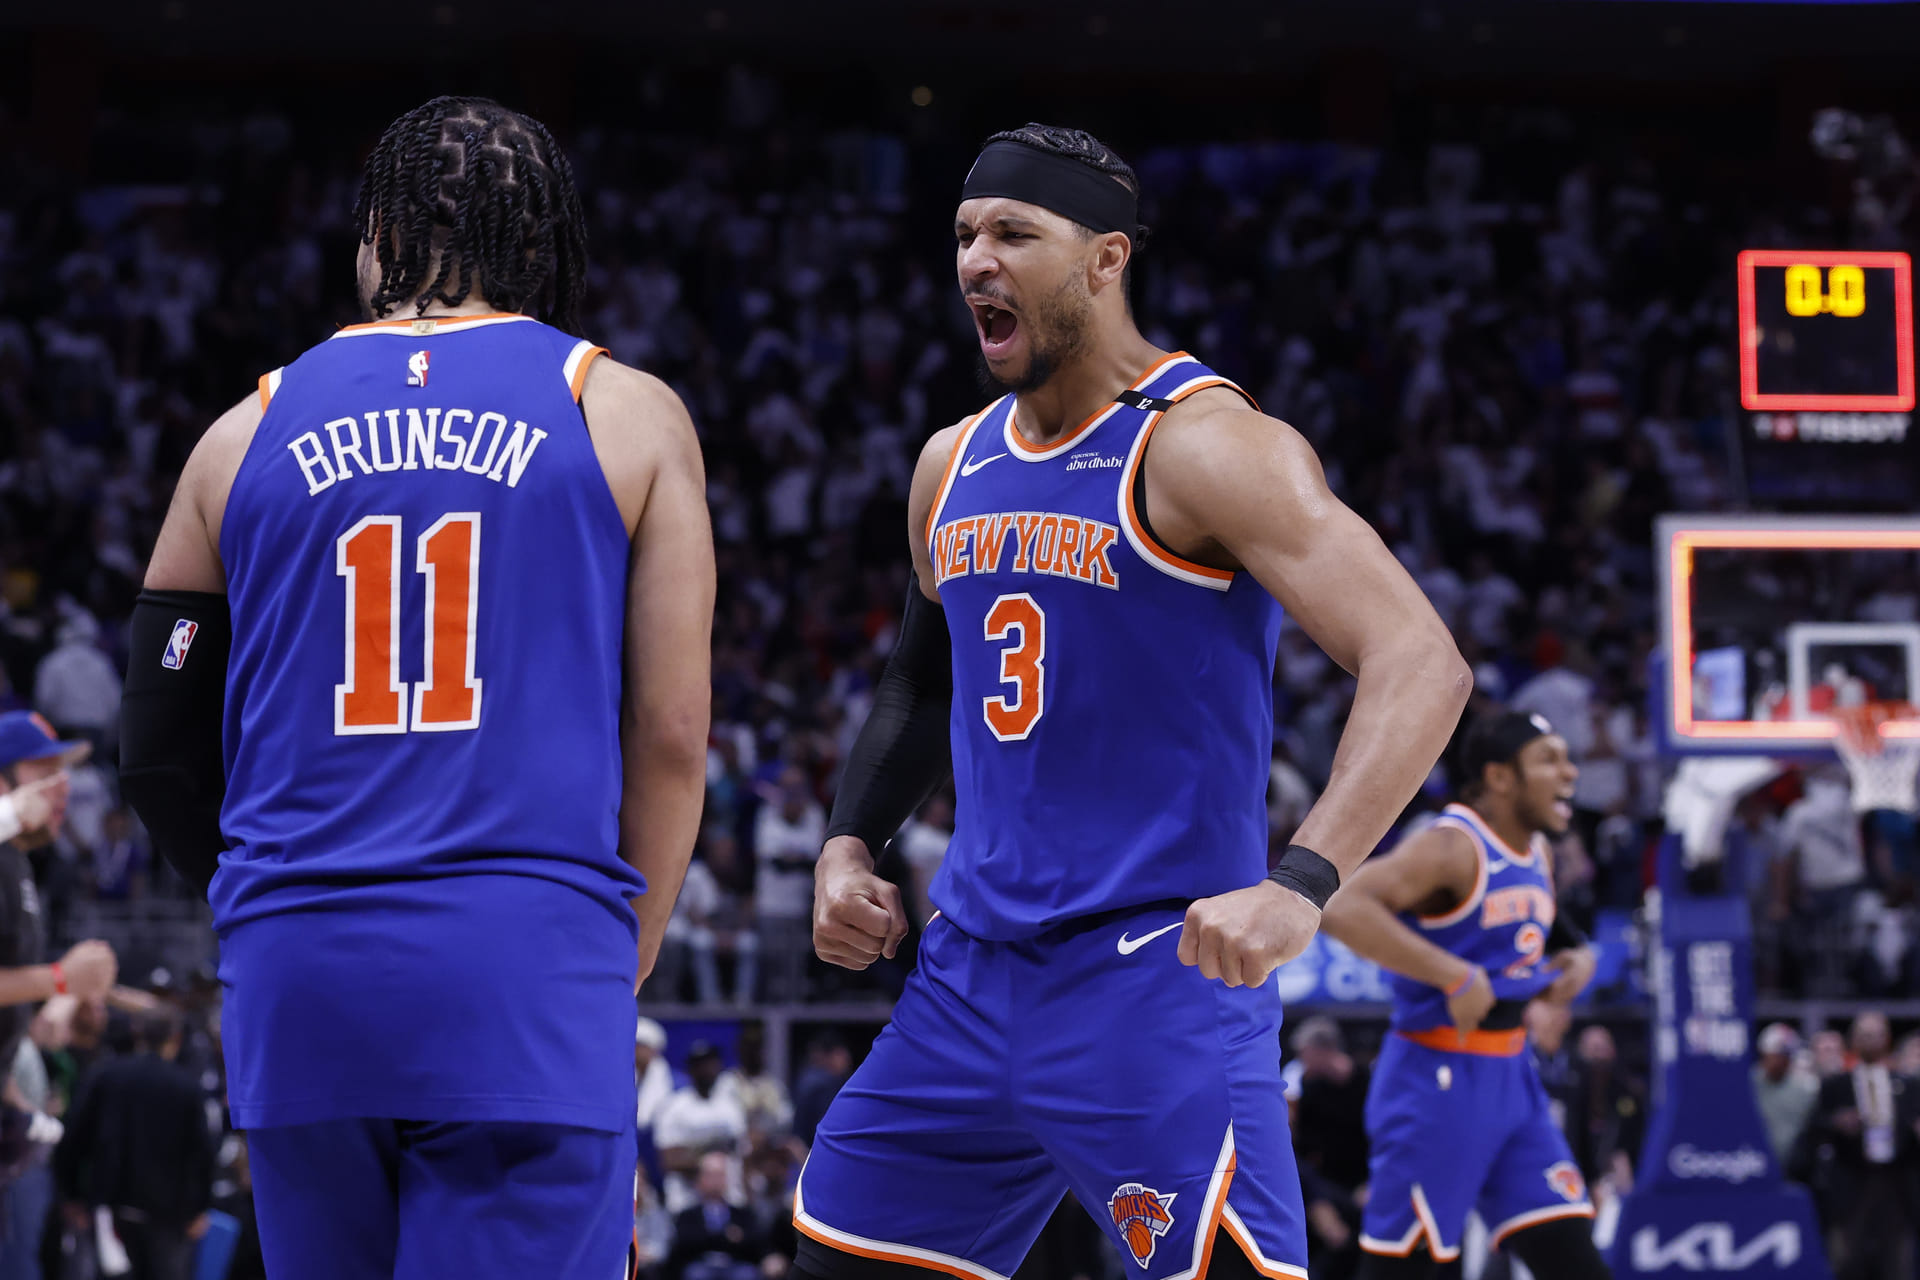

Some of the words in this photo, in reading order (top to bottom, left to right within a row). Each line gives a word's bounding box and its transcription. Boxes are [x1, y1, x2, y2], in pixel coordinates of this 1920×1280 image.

[1785, 264, 1866, 317] 0.0
[1136, 398, 1152, 410] 12
[288, 408, 548, 496] BRUNSON
[1066, 459, 1088, 471] abu
[1088, 456, 1125, 469] dhabi
[935, 512, 1014, 591] NEW
[1012, 511, 1120, 591] YORK
[334, 512, 482, 736] 11
[983, 592, 1045, 742] 3
[1503, 922, 1545, 980] 2
[1669, 1144, 1766, 1184] Google
[1113, 1191, 1170, 1226] KNICKS
